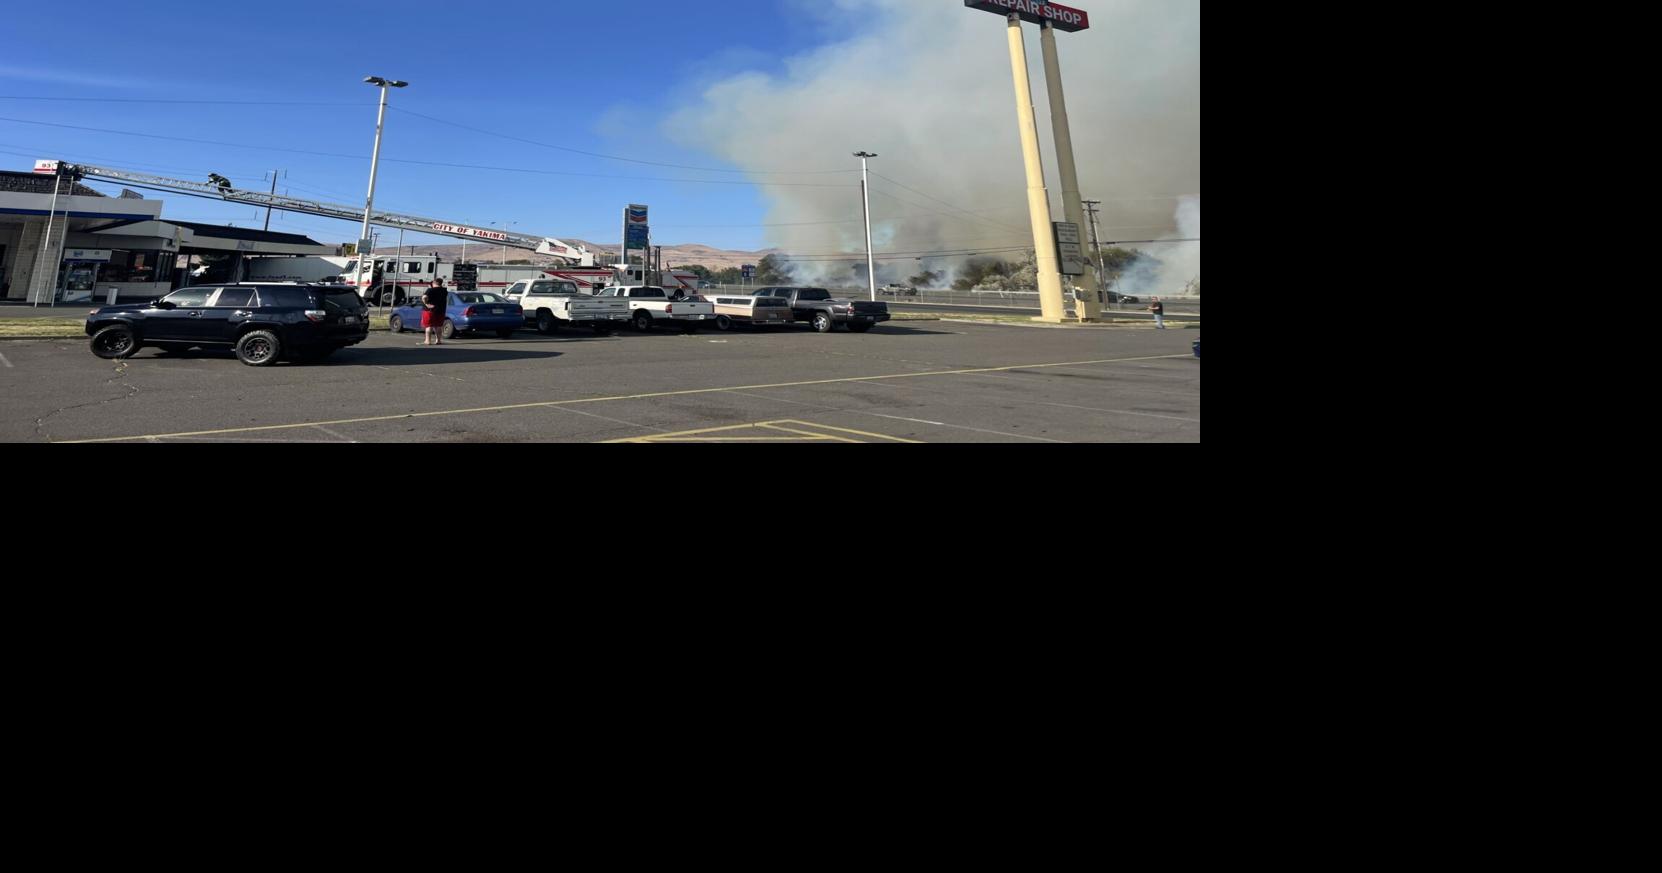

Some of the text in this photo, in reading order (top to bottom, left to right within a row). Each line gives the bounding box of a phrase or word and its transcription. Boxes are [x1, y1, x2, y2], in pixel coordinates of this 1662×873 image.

[1044, 5, 1082, 25] SHOP
[433, 223, 454, 232] CITY
[473, 229, 505, 240] YAKIMA
